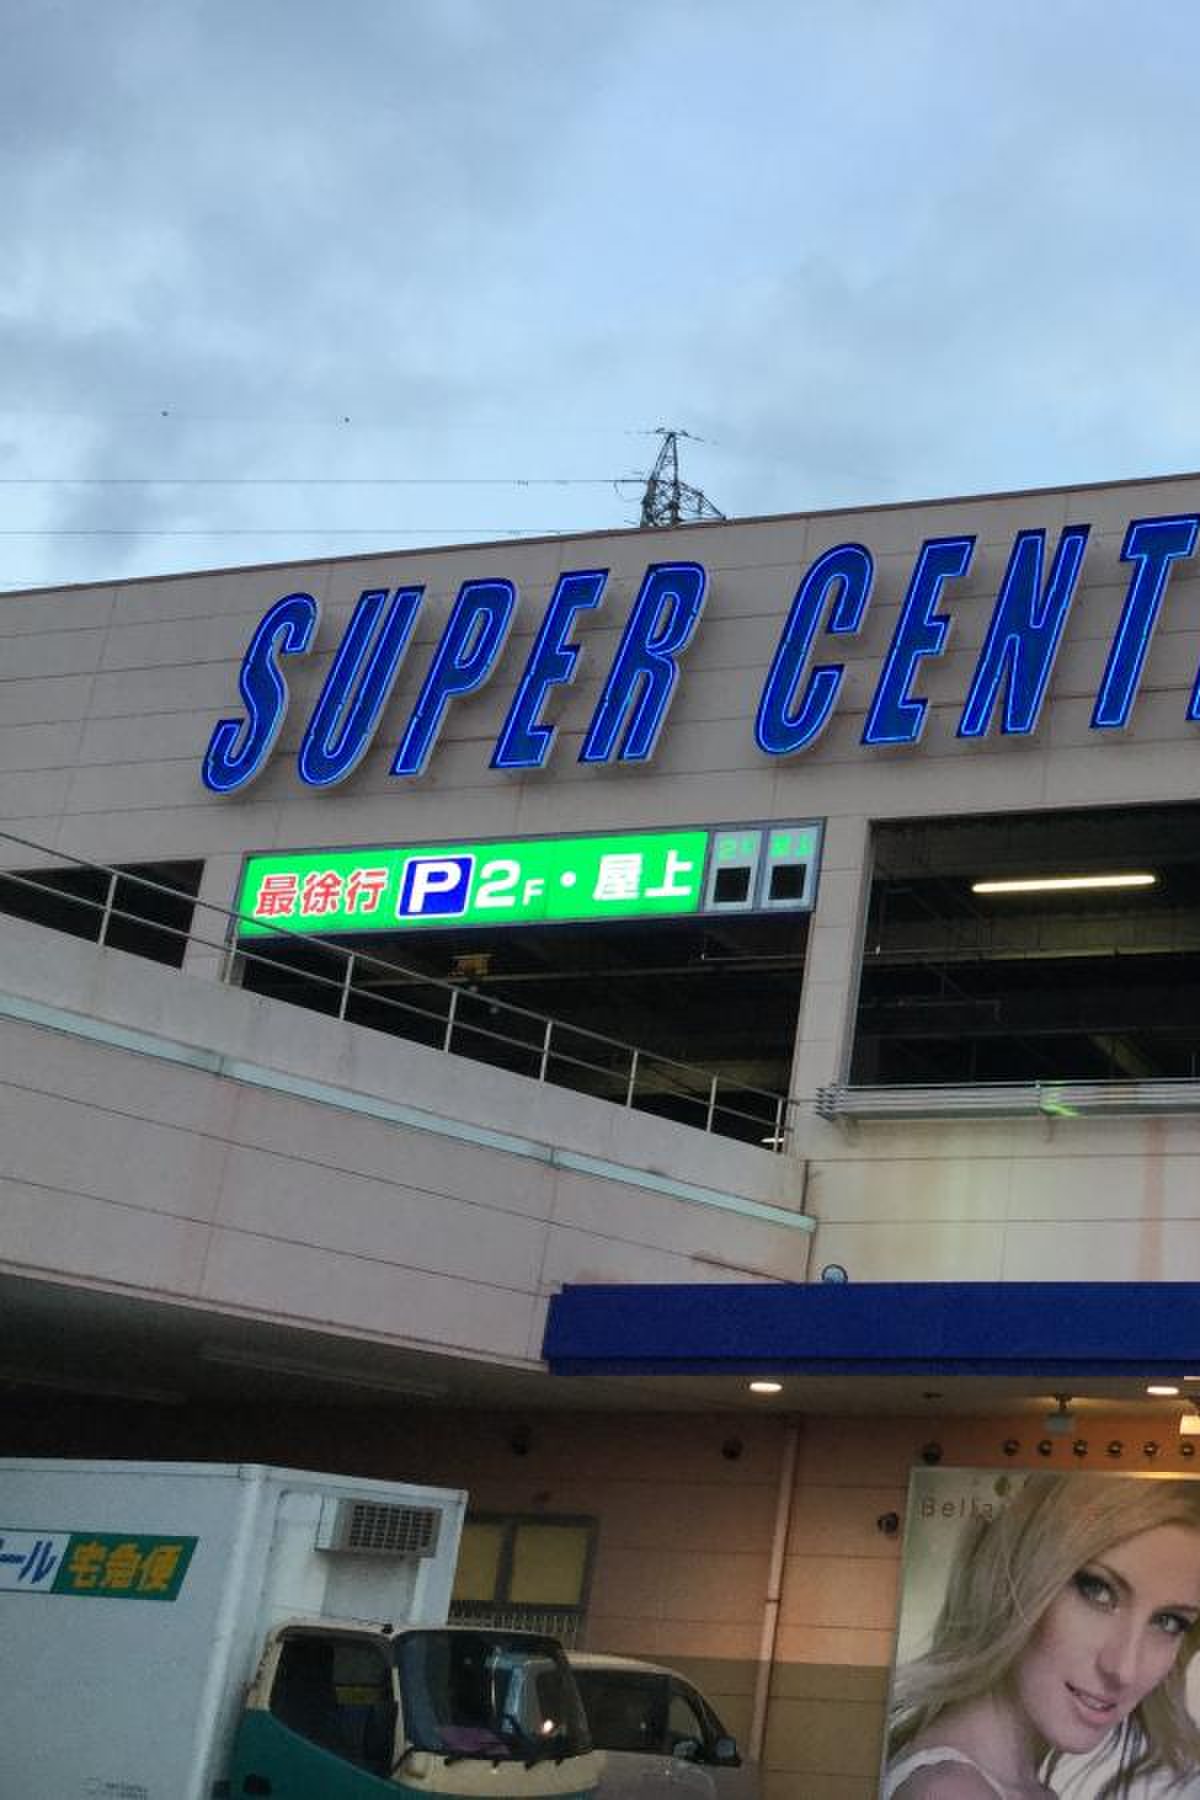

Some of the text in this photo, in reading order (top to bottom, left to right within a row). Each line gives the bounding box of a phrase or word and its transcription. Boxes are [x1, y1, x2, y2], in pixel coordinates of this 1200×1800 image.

[200, 559, 710, 796] SUPER
[254, 869, 389, 916] 最徐行
[0, 1538, 58, 1585] ール
